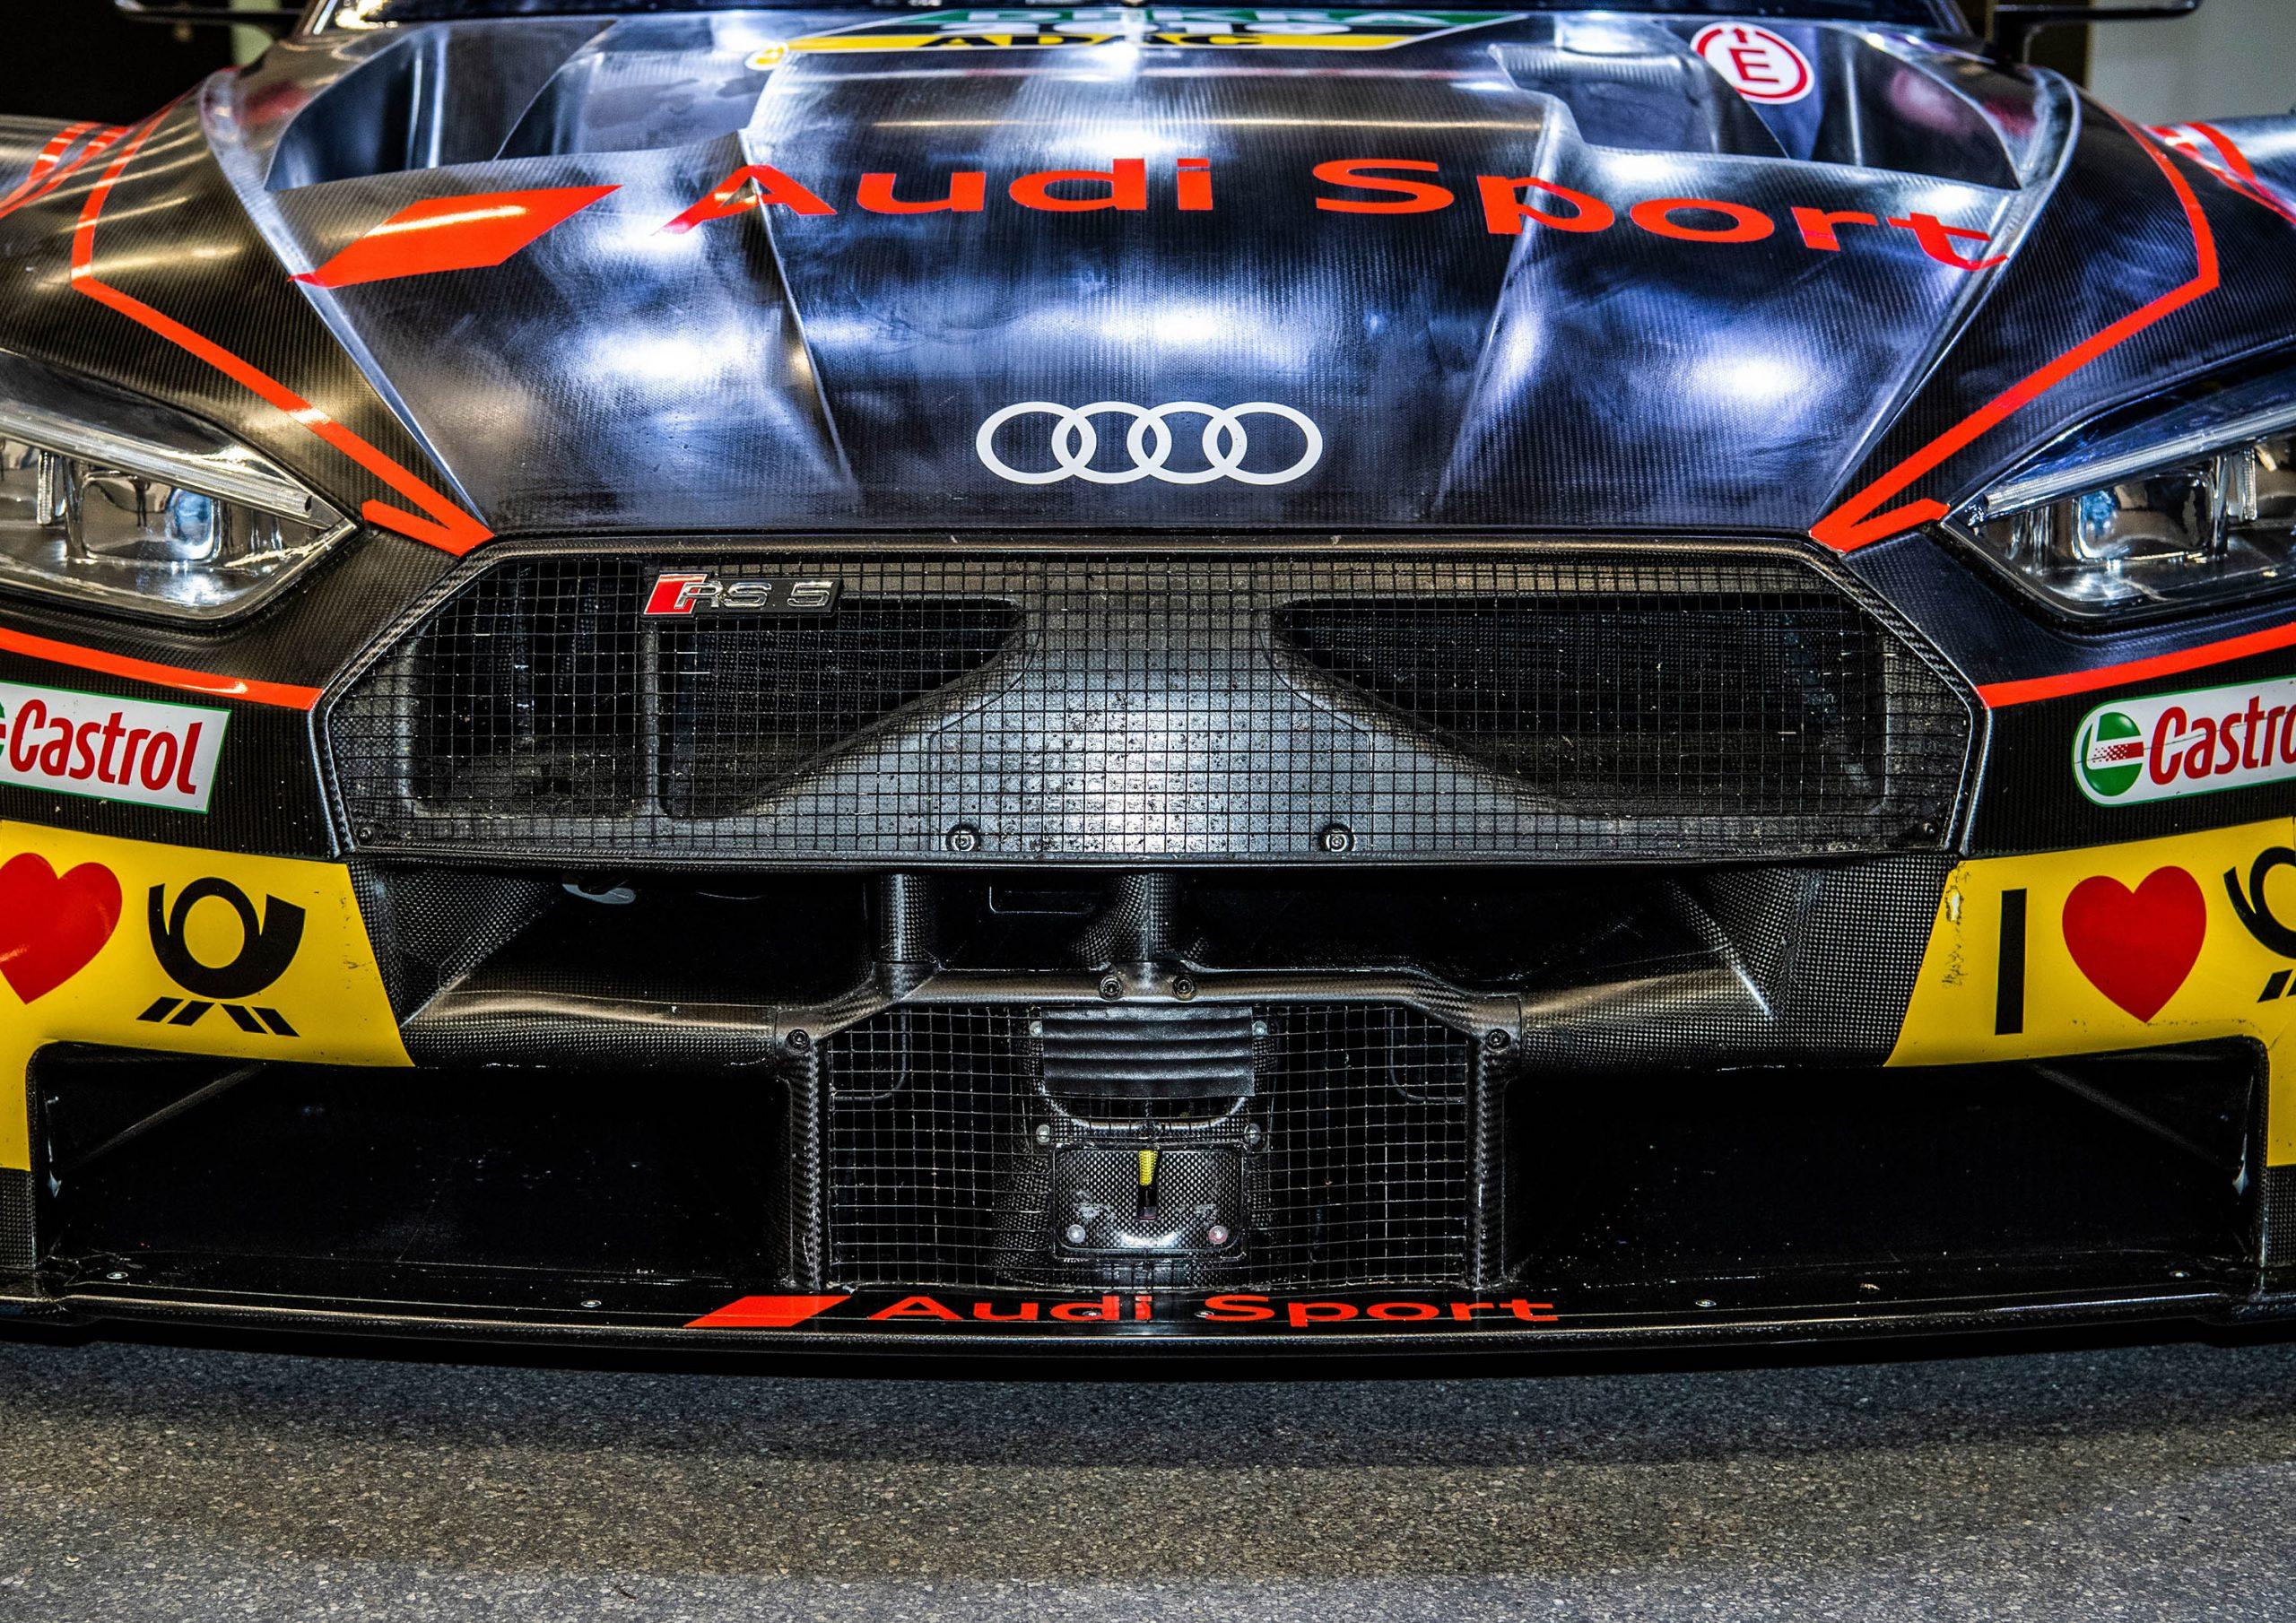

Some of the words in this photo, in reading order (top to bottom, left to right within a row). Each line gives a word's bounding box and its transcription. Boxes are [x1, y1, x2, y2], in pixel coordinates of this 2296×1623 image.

[966, 10, 1451, 25] DEKRA
[919, 34, 1263, 48] ADAC
[655, 158, 1214, 235] Audi
[1312, 158, 2009, 273] Sport
[674, 581, 772, 609] RS
[787, 581, 834, 607] 5
[9, 699, 203, 794] Castrol
[1994, 887, 2028, 1037] I
[867, 1294, 1152, 1322] Audi
[1204, 1294, 1560, 1327] Sport
